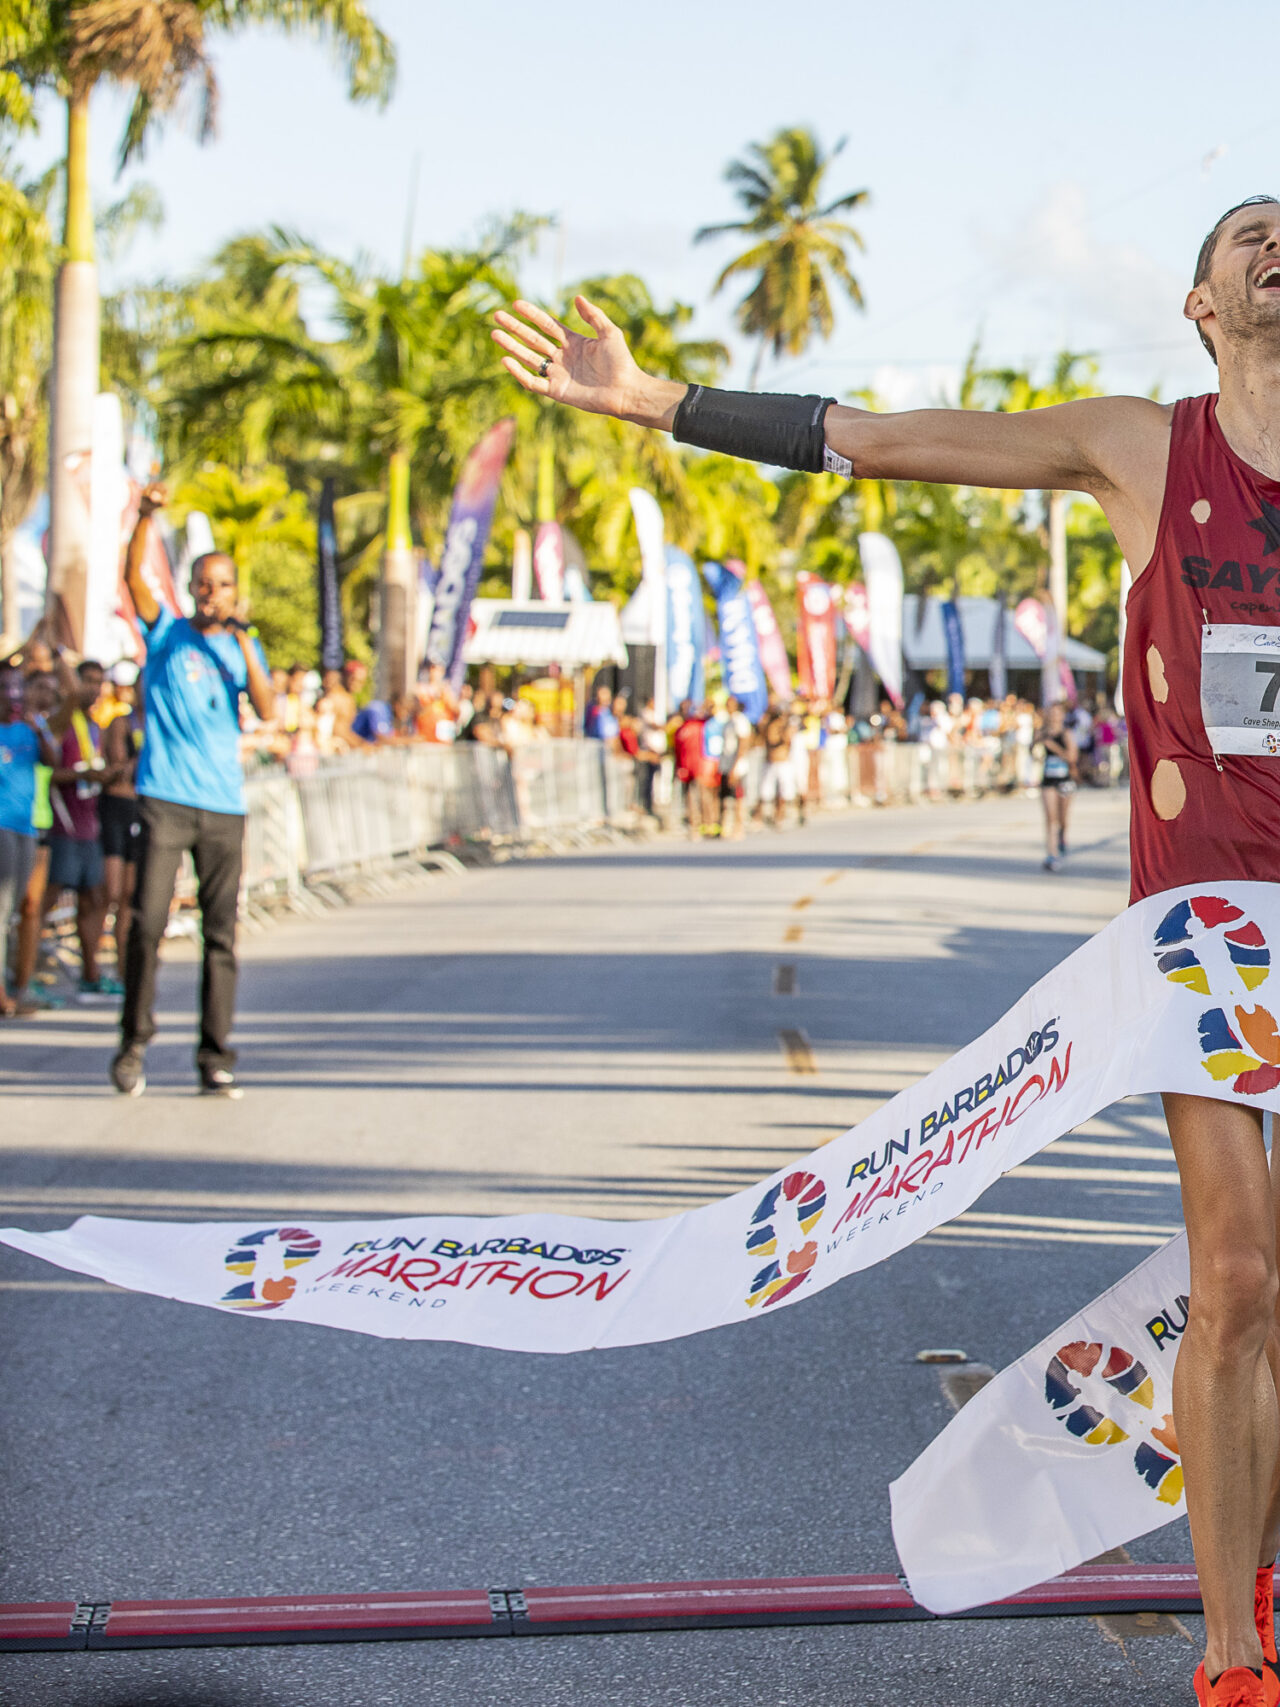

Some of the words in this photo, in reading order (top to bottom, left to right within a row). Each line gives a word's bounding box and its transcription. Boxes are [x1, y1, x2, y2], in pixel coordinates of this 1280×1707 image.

[1243, 717, 1260, 727] Cave
[846, 1128, 910, 1189] RUN
[920, 1018, 1059, 1146] BARBADOS
[831, 1041, 1073, 1234] MARATHON
[826, 1182, 945, 1254] WEEKEND
[314, 1252, 631, 1301] MARATHON
[343, 1236, 428, 1258] RUN
[431, 1236, 629, 1267] BARBADOS
[304, 1284, 447, 1309] WEEKEND
[1145, 1294, 1189, 1352] RU
